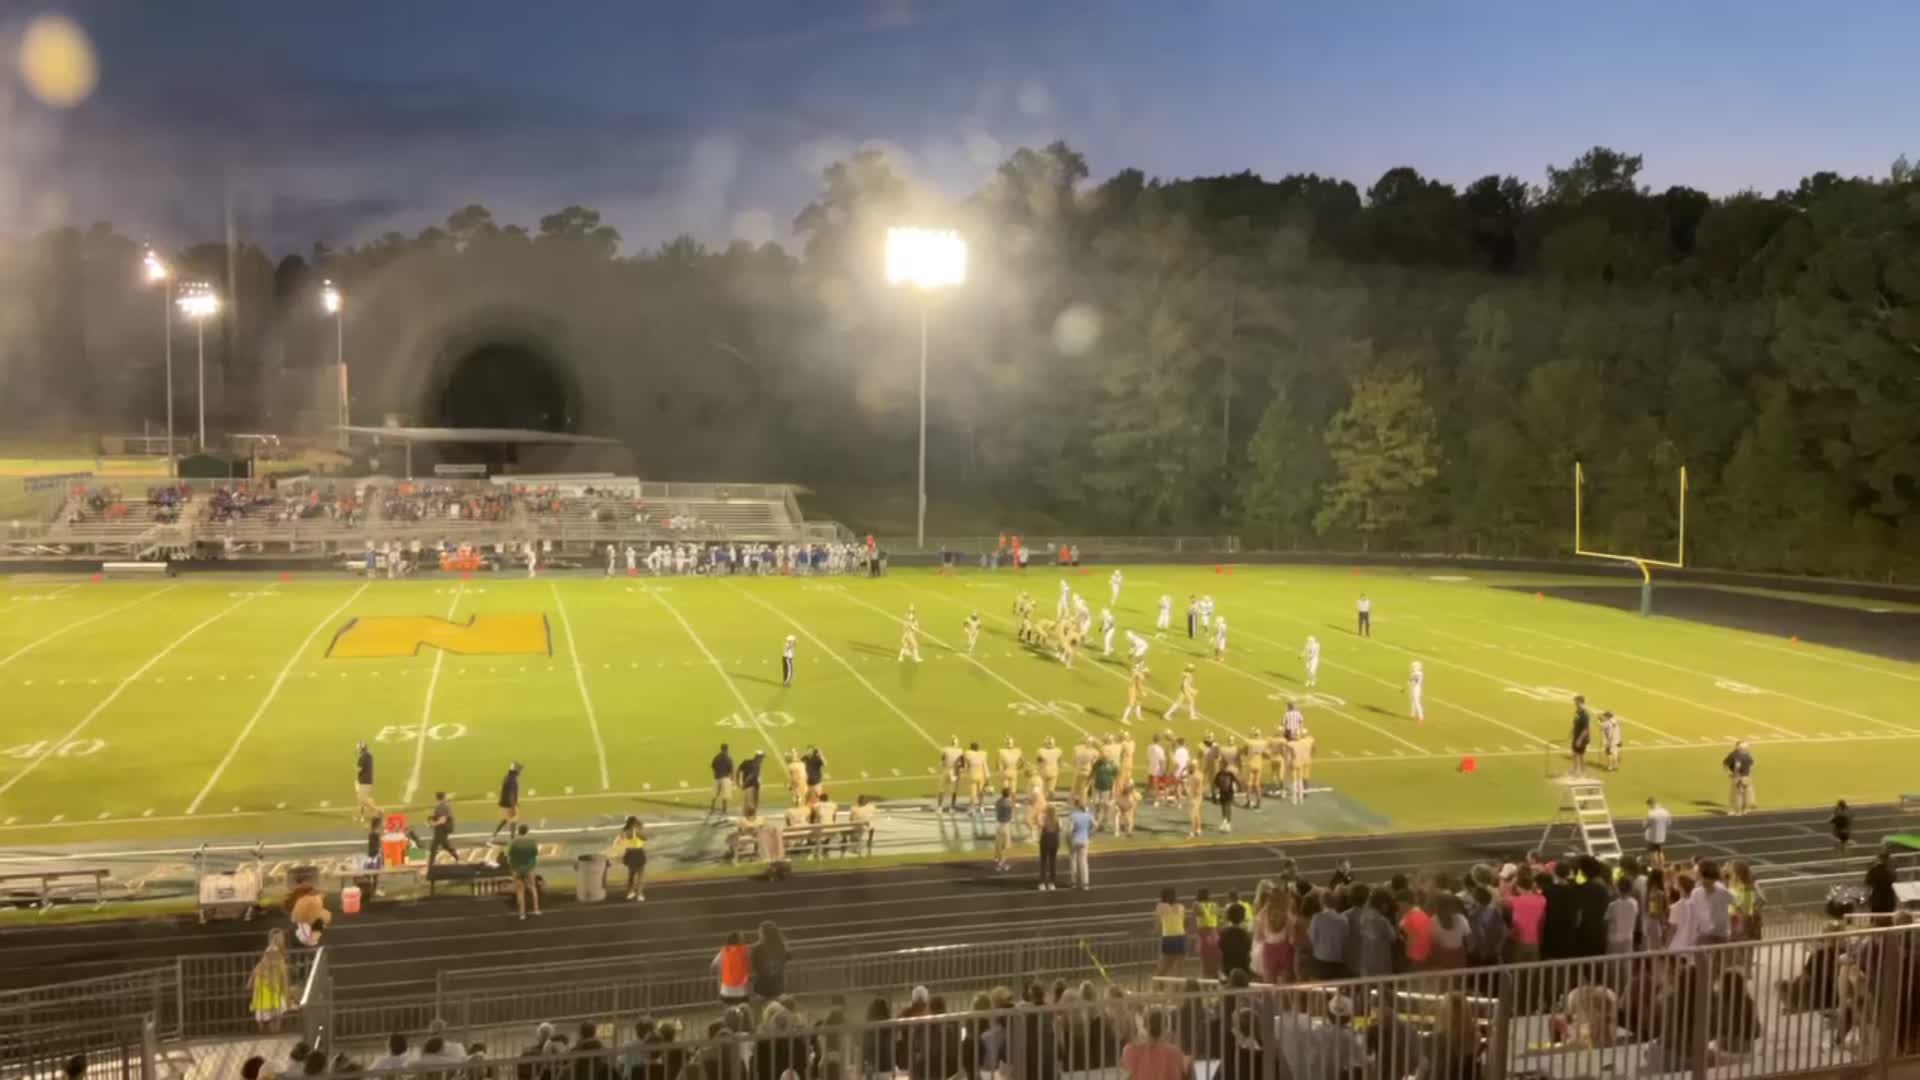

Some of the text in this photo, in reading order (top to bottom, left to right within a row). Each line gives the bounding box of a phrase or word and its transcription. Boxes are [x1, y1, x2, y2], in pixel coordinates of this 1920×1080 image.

[324, 612, 553, 658] N
[713, 711, 796, 729] 40
[375, 722, 467, 743] 50
[0, 738, 106, 759] 40
